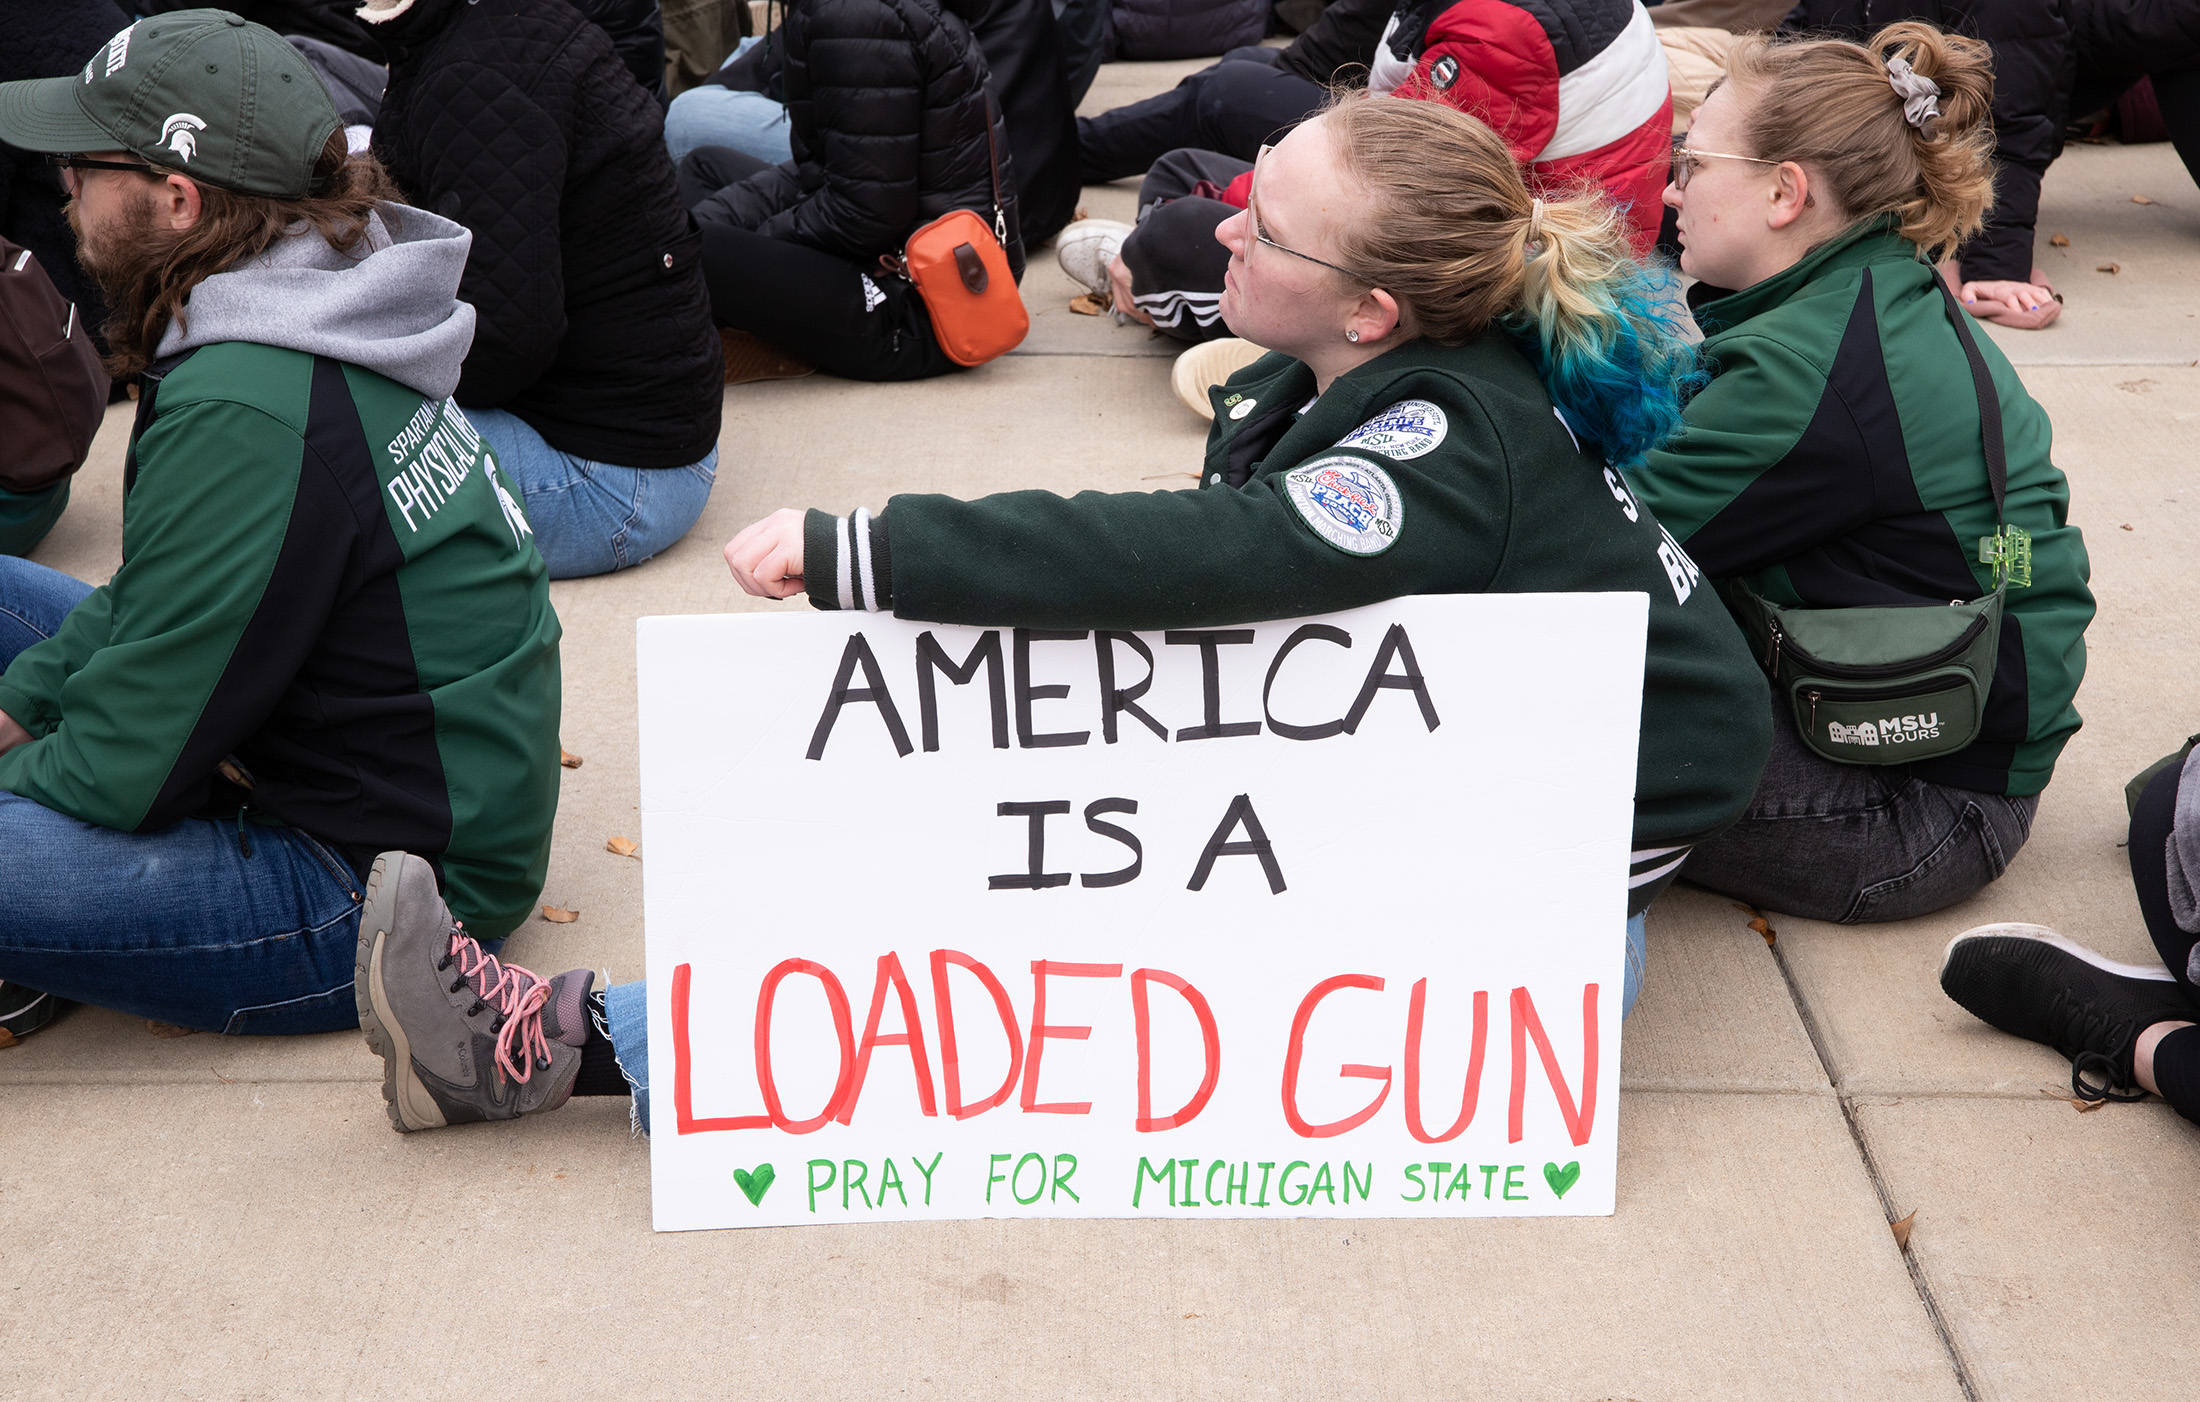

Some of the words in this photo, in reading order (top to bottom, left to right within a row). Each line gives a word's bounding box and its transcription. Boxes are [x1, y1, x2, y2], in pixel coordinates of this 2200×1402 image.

[387, 420, 476, 533] PHYSICAL
[1310, 482, 1374, 530] PEACH
[1310, 516, 1358, 550] MARCHING
[1360, 533, 1383, 551] BAND
[806, 622, 1441, 760] AMERICA
[1881, 727, 1940, 745] TOURS
[988, 797, 1144, 891] IS
[1187, 793, 1287, 895] A
[671, 949, 1221, 1135] LOADED
[1281, 974, 1600, 1147] GUN
[808, 1152, 943, 1212] PRAY
[986, 1153, 1080, 1205] FOR
[1133, 1157, 1373, 1208] MICHIGAN
[1402, 1162, 1530, 1202] STATE
